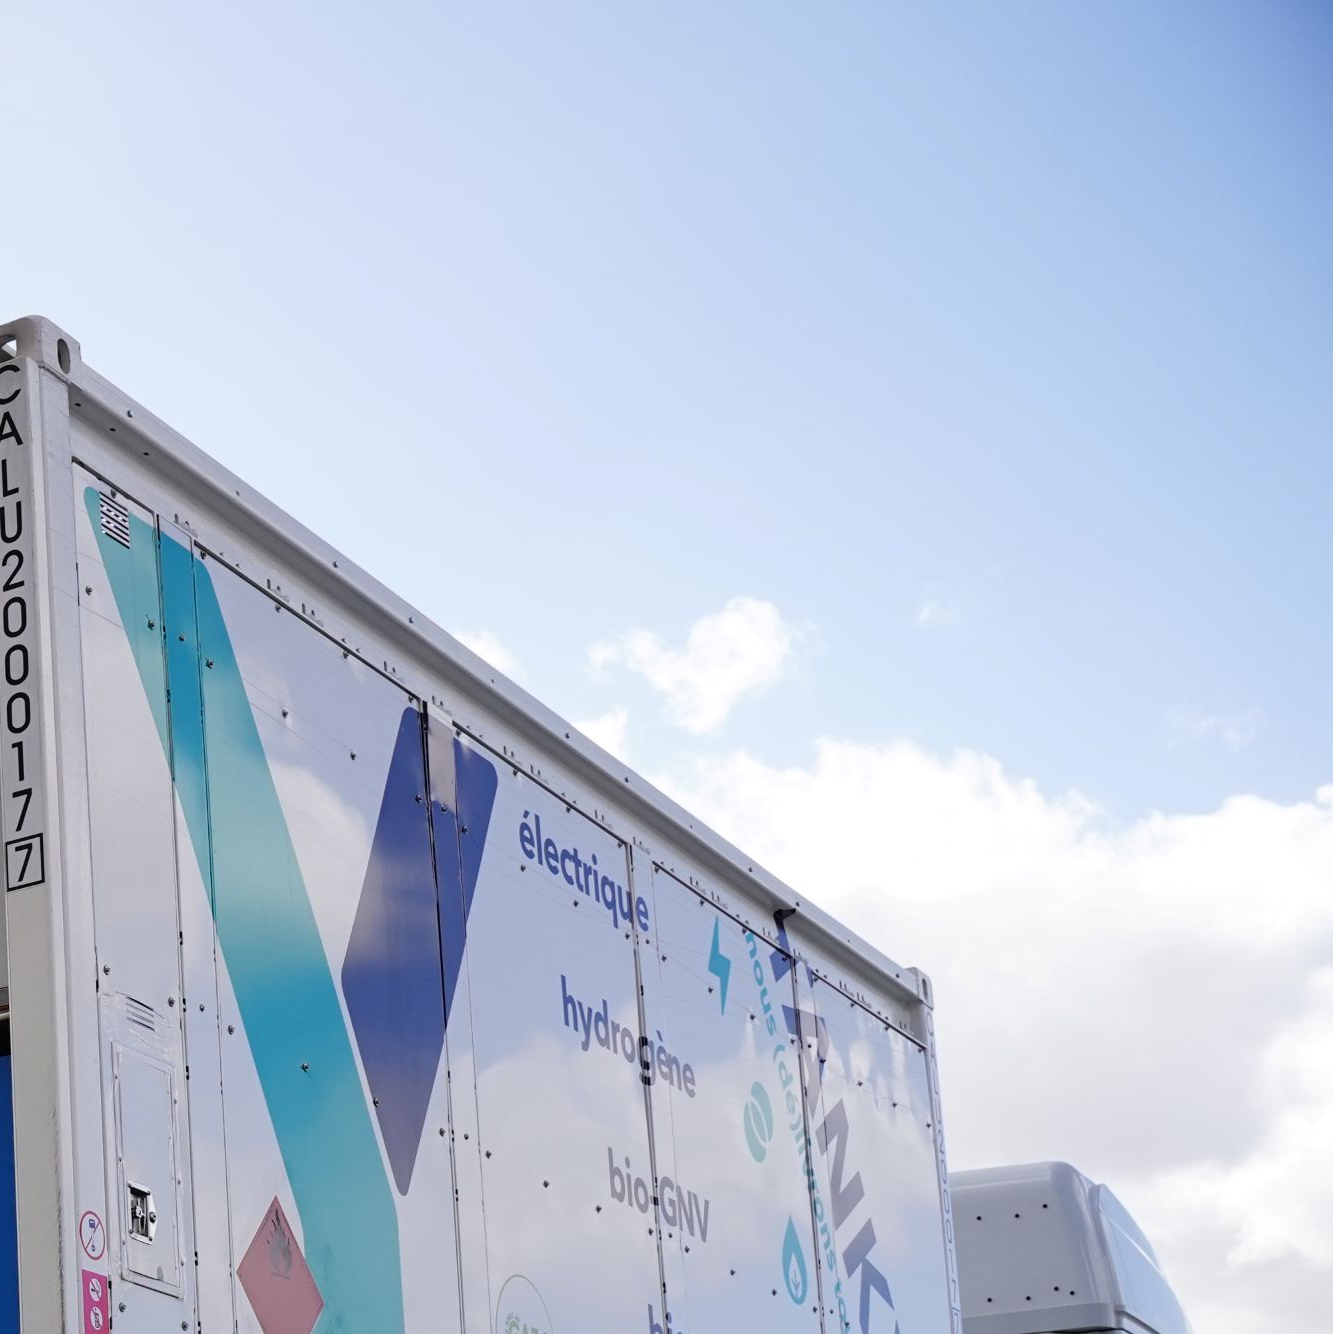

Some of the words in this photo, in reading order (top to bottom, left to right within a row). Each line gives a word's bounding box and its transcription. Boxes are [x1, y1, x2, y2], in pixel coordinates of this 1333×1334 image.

[519, 810, 650, 932] électrique
[561, 974, 697, 1099] hydrogène
[745, 932, 777, 1037] nous
[607, 1147, 710, 1243] bio-GNV
